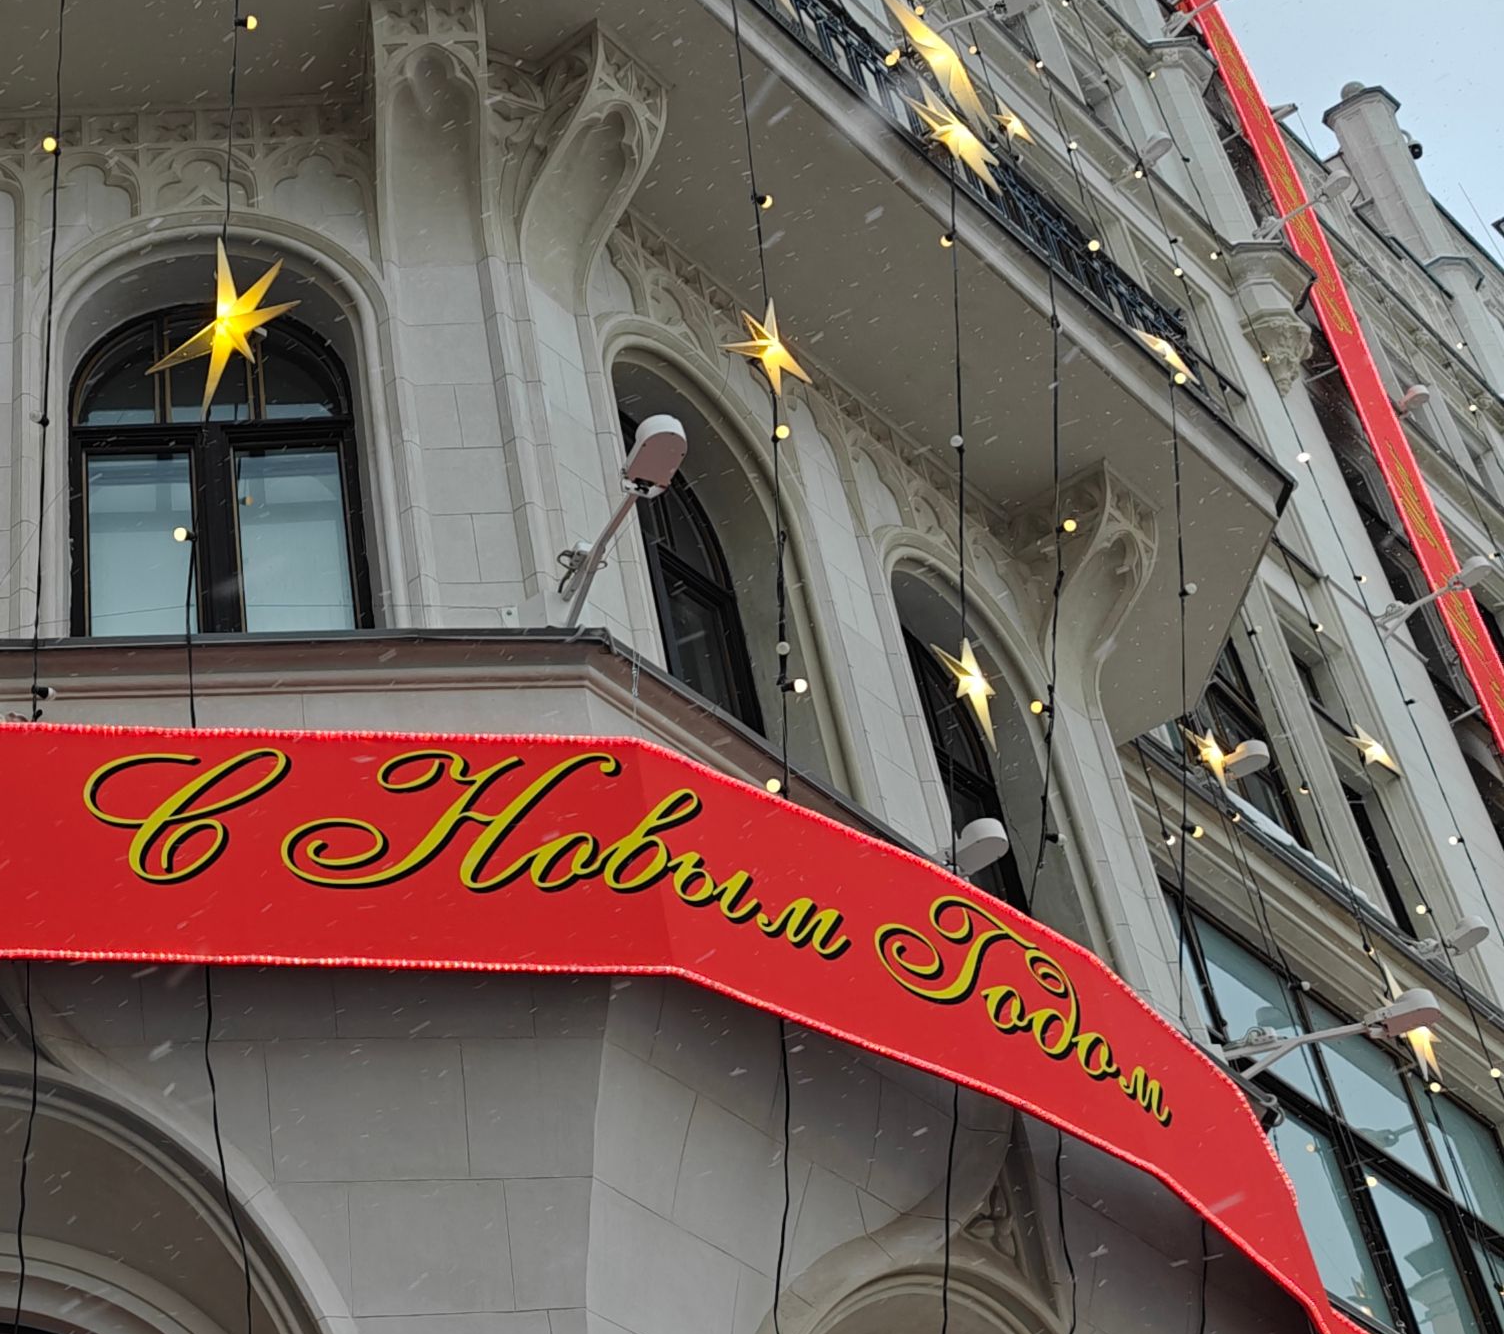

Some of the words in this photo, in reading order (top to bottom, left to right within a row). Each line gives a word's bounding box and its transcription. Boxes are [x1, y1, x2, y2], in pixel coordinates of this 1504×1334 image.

[83, 747, 293, 884] С
[281, 750, 850, 959] Новым
[874, 894, 1173, 1127] Годом
